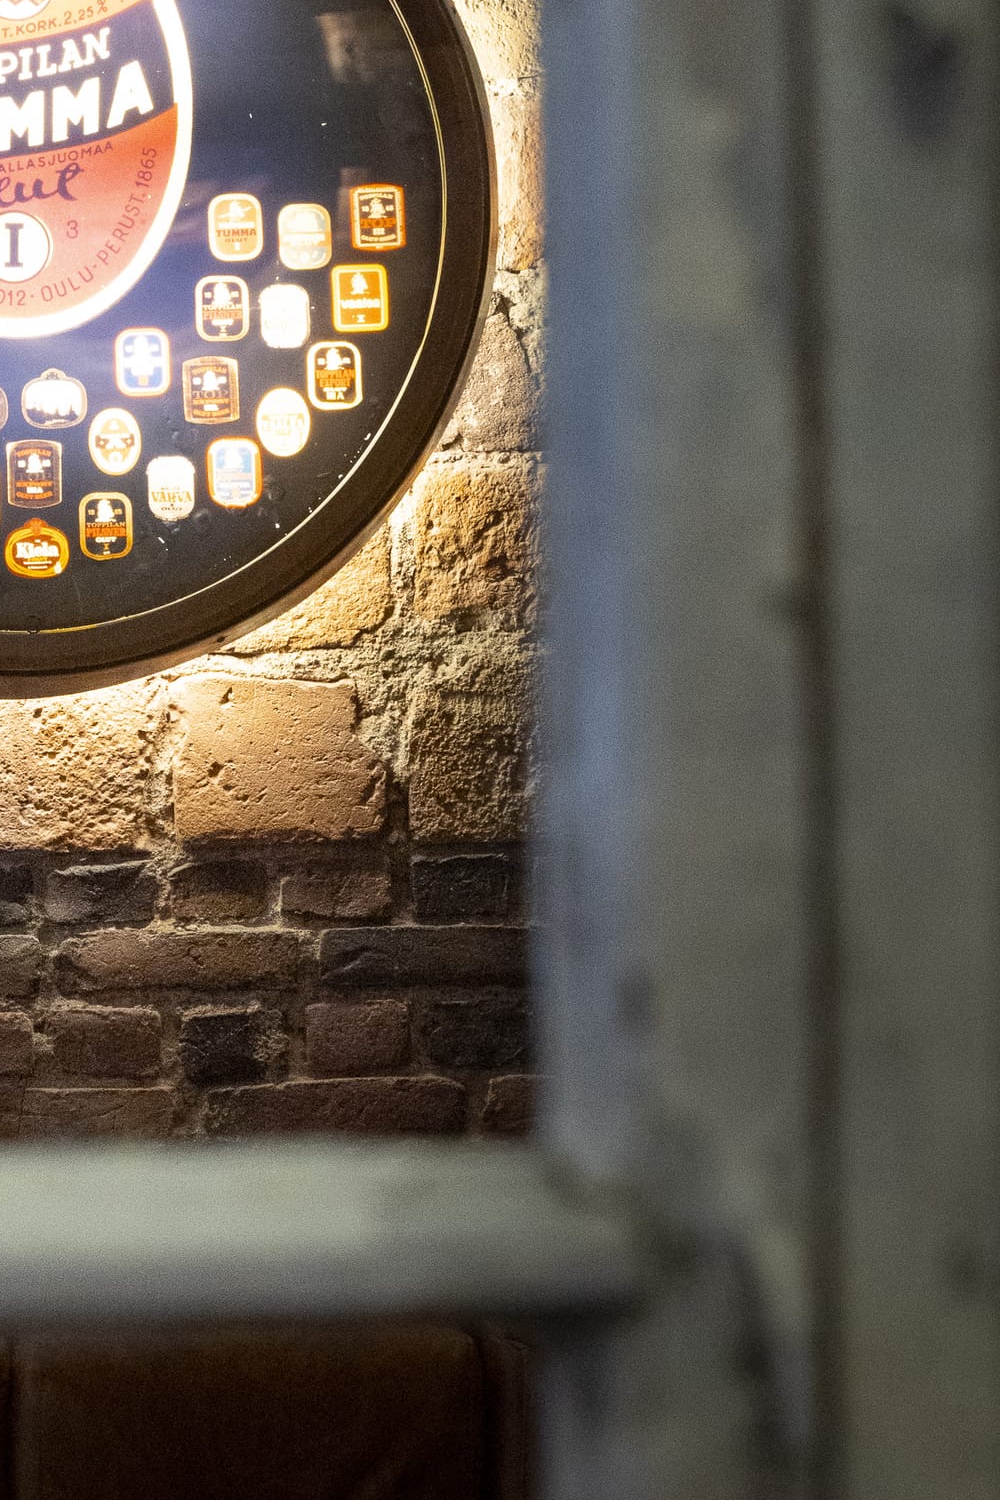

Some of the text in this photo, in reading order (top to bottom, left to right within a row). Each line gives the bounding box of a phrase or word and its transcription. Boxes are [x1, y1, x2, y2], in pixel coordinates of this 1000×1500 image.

[66, 220, 78, 239] 3
[216, 228, 257, 237] TUMMA
[86, 521, 126, 529] TOPPILAN
[85, 527, 127, 538] PILSNER
